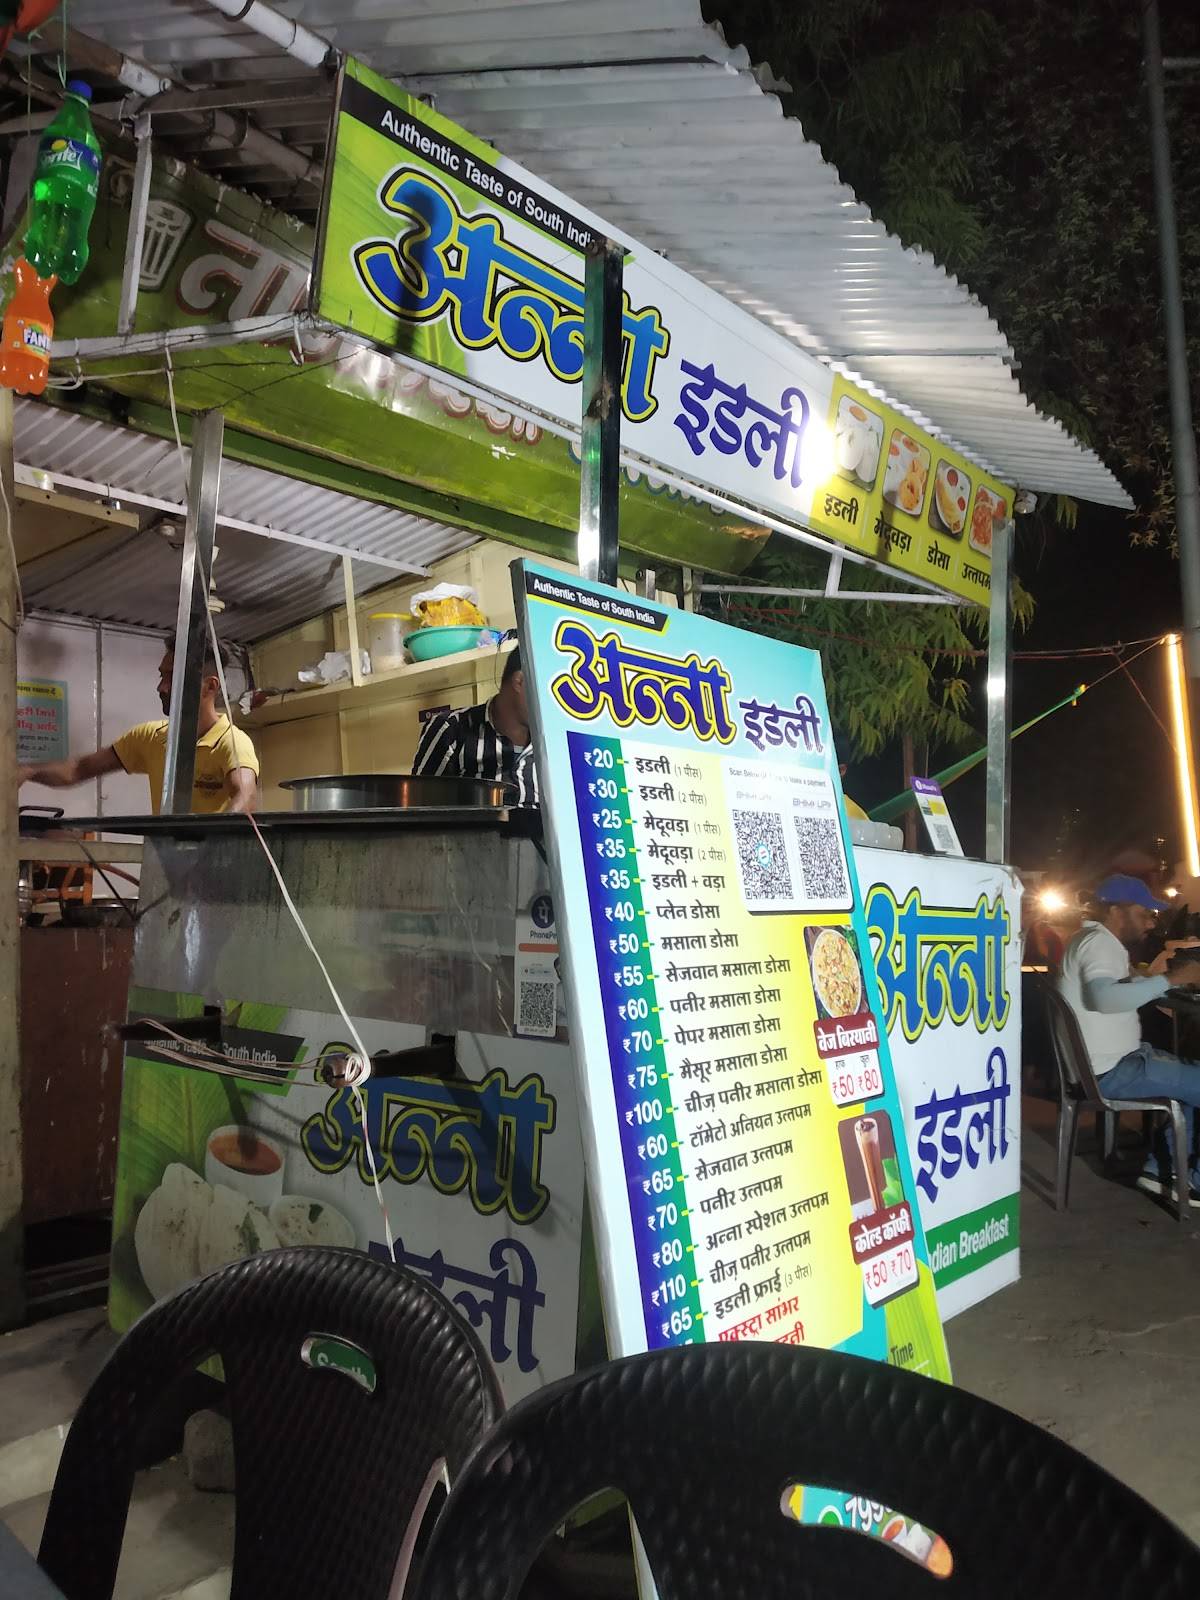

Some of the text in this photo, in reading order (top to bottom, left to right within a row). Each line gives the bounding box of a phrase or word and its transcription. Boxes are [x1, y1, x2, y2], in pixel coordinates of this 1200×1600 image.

[381, 110, 460, 171] Authentic
[463, 158, 504, 198] Taste
[507, 189, 523, 209] of
[524, 197, 565, 234] South
[674, 359, 809, 488] इडली
[823, 493, 859, 525] इडली
[874, 511, 912, 552] मेदूवड़ा
[927, 541, 951, 571] डोसा
[534, 579, 656, 625] Authentic Taste of South India
[551, 620, 824, 753] अन्ना इडली
[584, 748, 614, 769] ₹20
[634, 756, 671, 775] इडली
[588, 779, 618, 799] ₹30
[638, 783, 675, 802] इडली
[592, 808, 622, 829] ₹25
[643, 810, 690, 838] मेदूवड़ा
[596, 838, 626, 858] ₹35
[647, 839, 694, 865] मेदूवड़ा
[600, 869, 630, 890] ₹35
[651, 869, 688, 890] इडली
[702, 875, 726, 892] वड़ा
[605, 899, 720, 922] ₹40 प्लेन डोसा
[609, 928, 739, 954] ₹50 मसाला डोसा
[614, 955, 791, 987] ₹55 सेजवान मसाला डोसा
[866, 882, 1011, 1044] अन्ना
[618, 985, 781, 1021] ₹60 पनीर मसाला डोसा
[623, 1014, 781, 1054] ₹70 पेपर मसाला डोसा
[817, 1020, 878, 1051] वेज बिरयानी
[627, 1044, 788, 1089] ₹75 मैसूर मसाला डोसा
[832, 1069, 879, 1098] ₹50 ₹80
[625, 1067, 823, 1126] ₹100 चीज़ पनीर मसाला डोसा
[638, 1133, 668, 1160] ₹60
[730, 1113, 773, 1136] अनियन
[775, 1103, 812, 1125] उत्तपम
[914, 1046, 1011, 1203] इडली
[643, 1140, 793, 1196] ₹65 सेजवान उत्तपम
[647, 1175, 783, 1231] ₹70 पनीर उत्तपम
[652, 1192, 830, 1268] ₹80 अन्ना स्पेशल उत्तपम
[854, 1207, 911, 1253] कोल्ड कॉफी
[931, 1213, 1009, 1274] dian Breakfast
[651, 1230, 812, 1307] ₹110 चीज़ पनीर उत्तपम
[865, 1249, 912, 1290] ₹50 ₹70
[661, 1306, 693, 1339] ₹65
[714, 1283, 750, 1319] इडली
[753, 1267, 783, 1302] फ्राई
[765, 1296, 799, 1322] सांभर
[890, 1342, 914, 1367] Time
